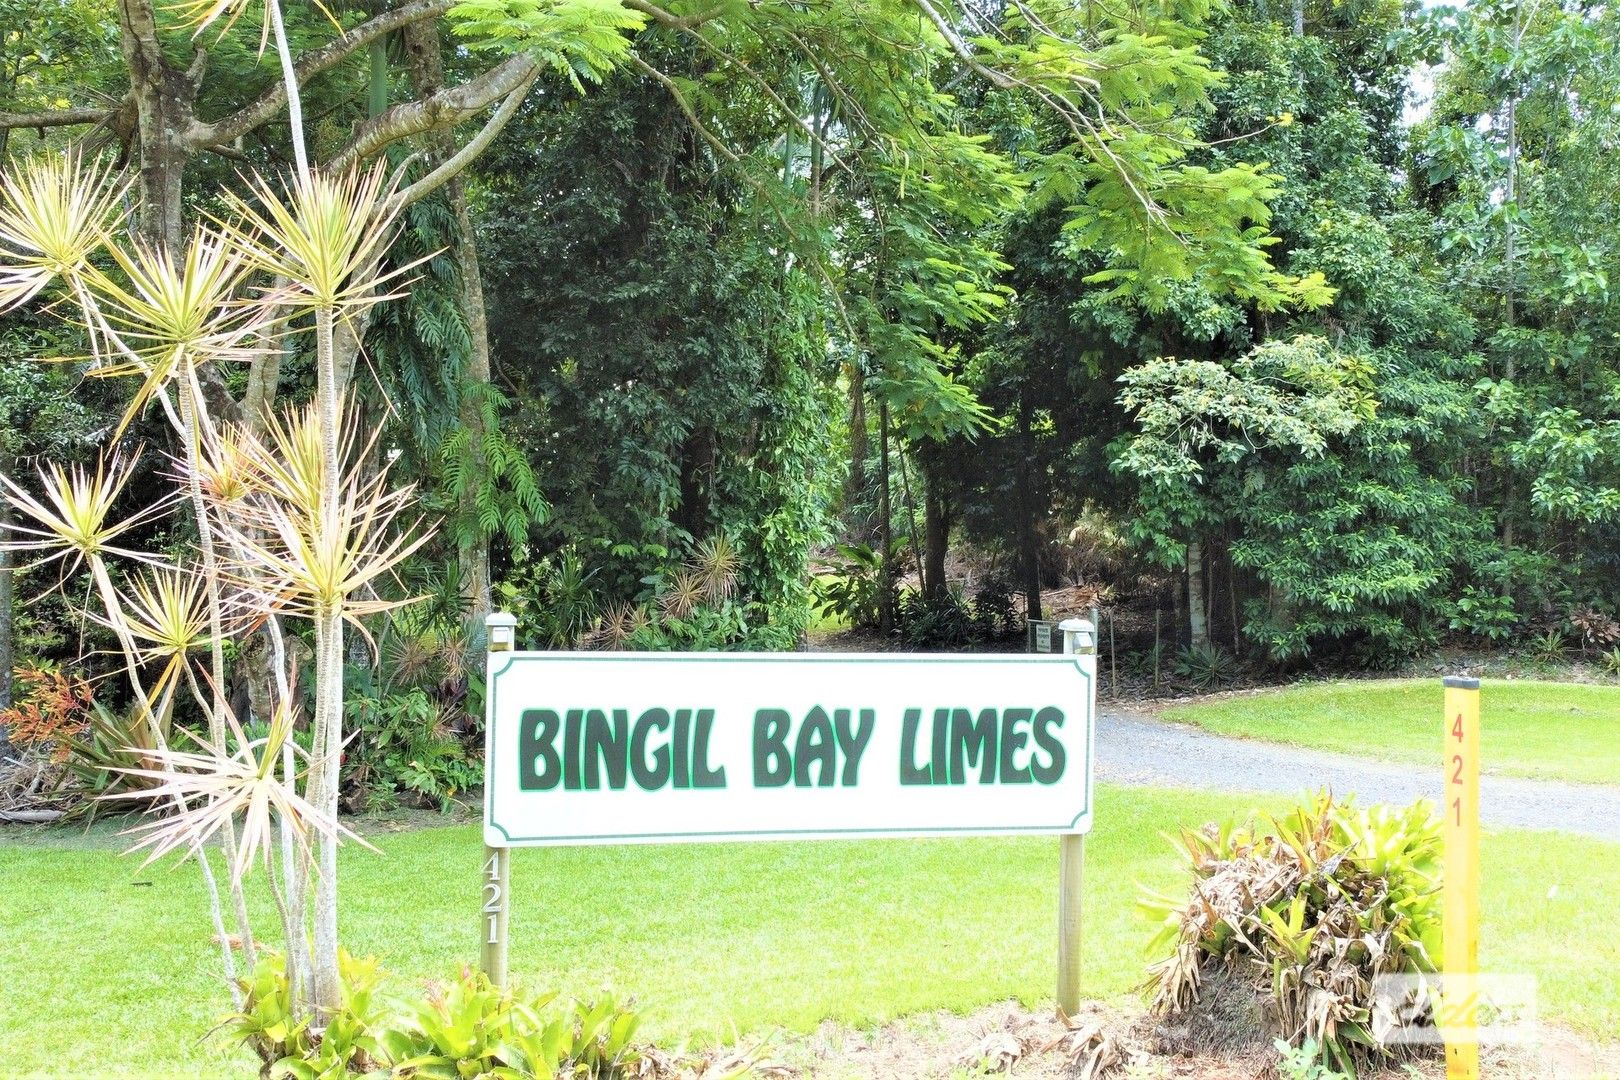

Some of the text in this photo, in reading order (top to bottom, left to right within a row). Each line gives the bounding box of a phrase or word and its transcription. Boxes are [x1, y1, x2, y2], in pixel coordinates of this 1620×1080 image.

[518, 704, 1066, 792] BINGIL BAY LIMES
[1451, 713, 1464, 827] 421
[478, 851, 502, 944] 421
